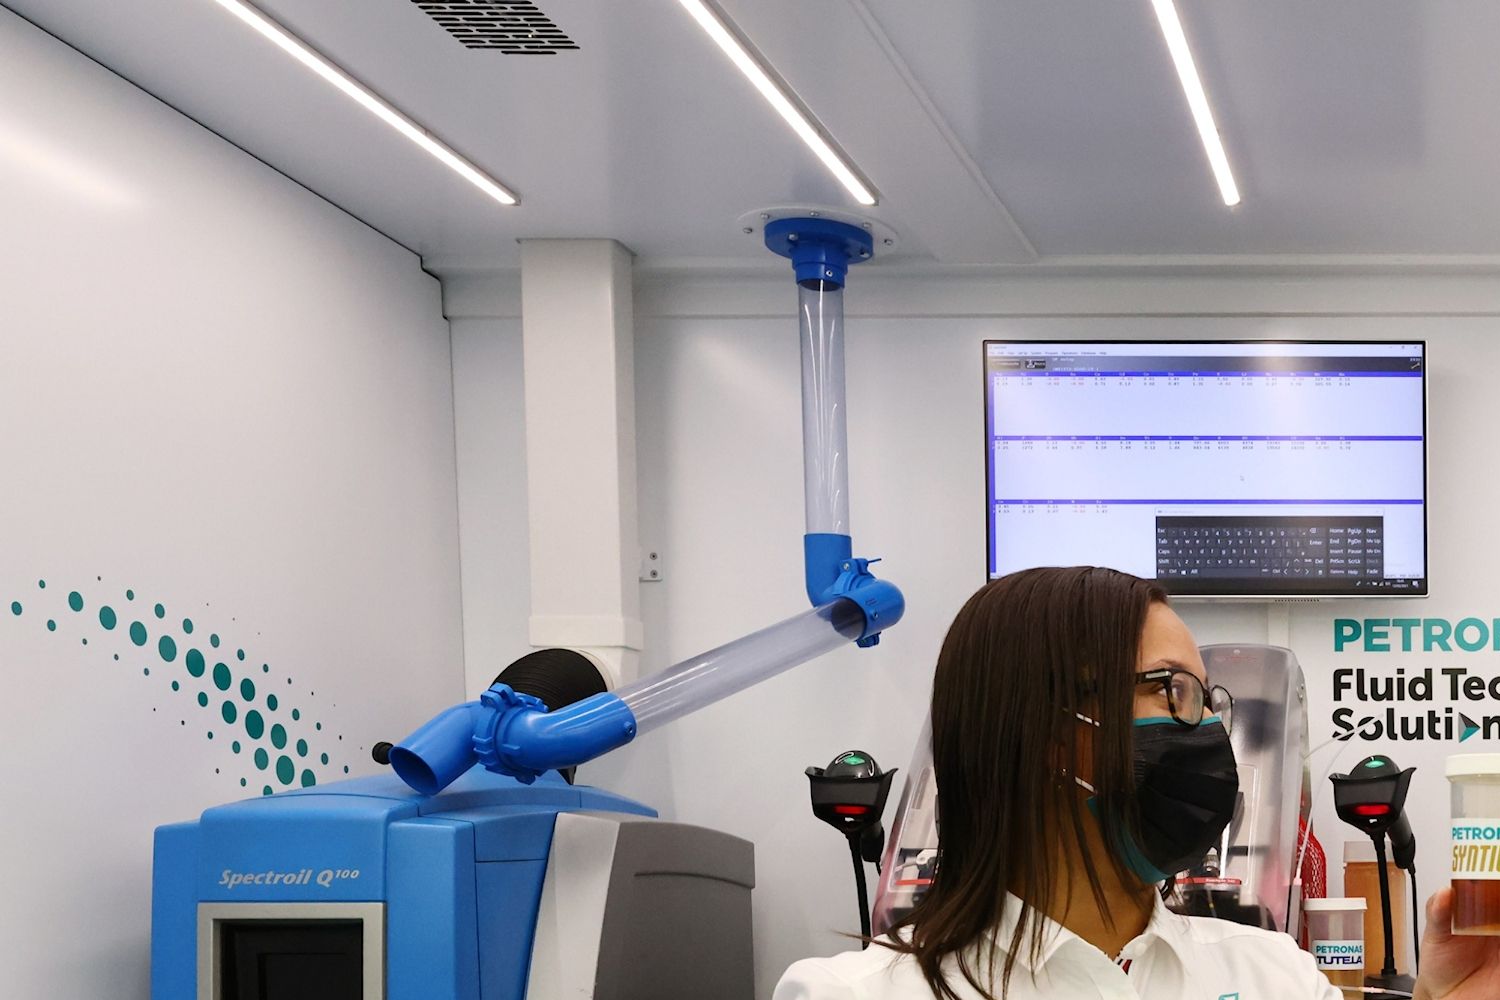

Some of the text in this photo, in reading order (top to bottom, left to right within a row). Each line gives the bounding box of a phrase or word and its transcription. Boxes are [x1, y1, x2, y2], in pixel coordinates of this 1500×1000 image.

[1332, 667, 1433, 701] Fluid
[219, 869, 313, 889] Spectroil
[1317, 956, 1362, 964] TUTELA
